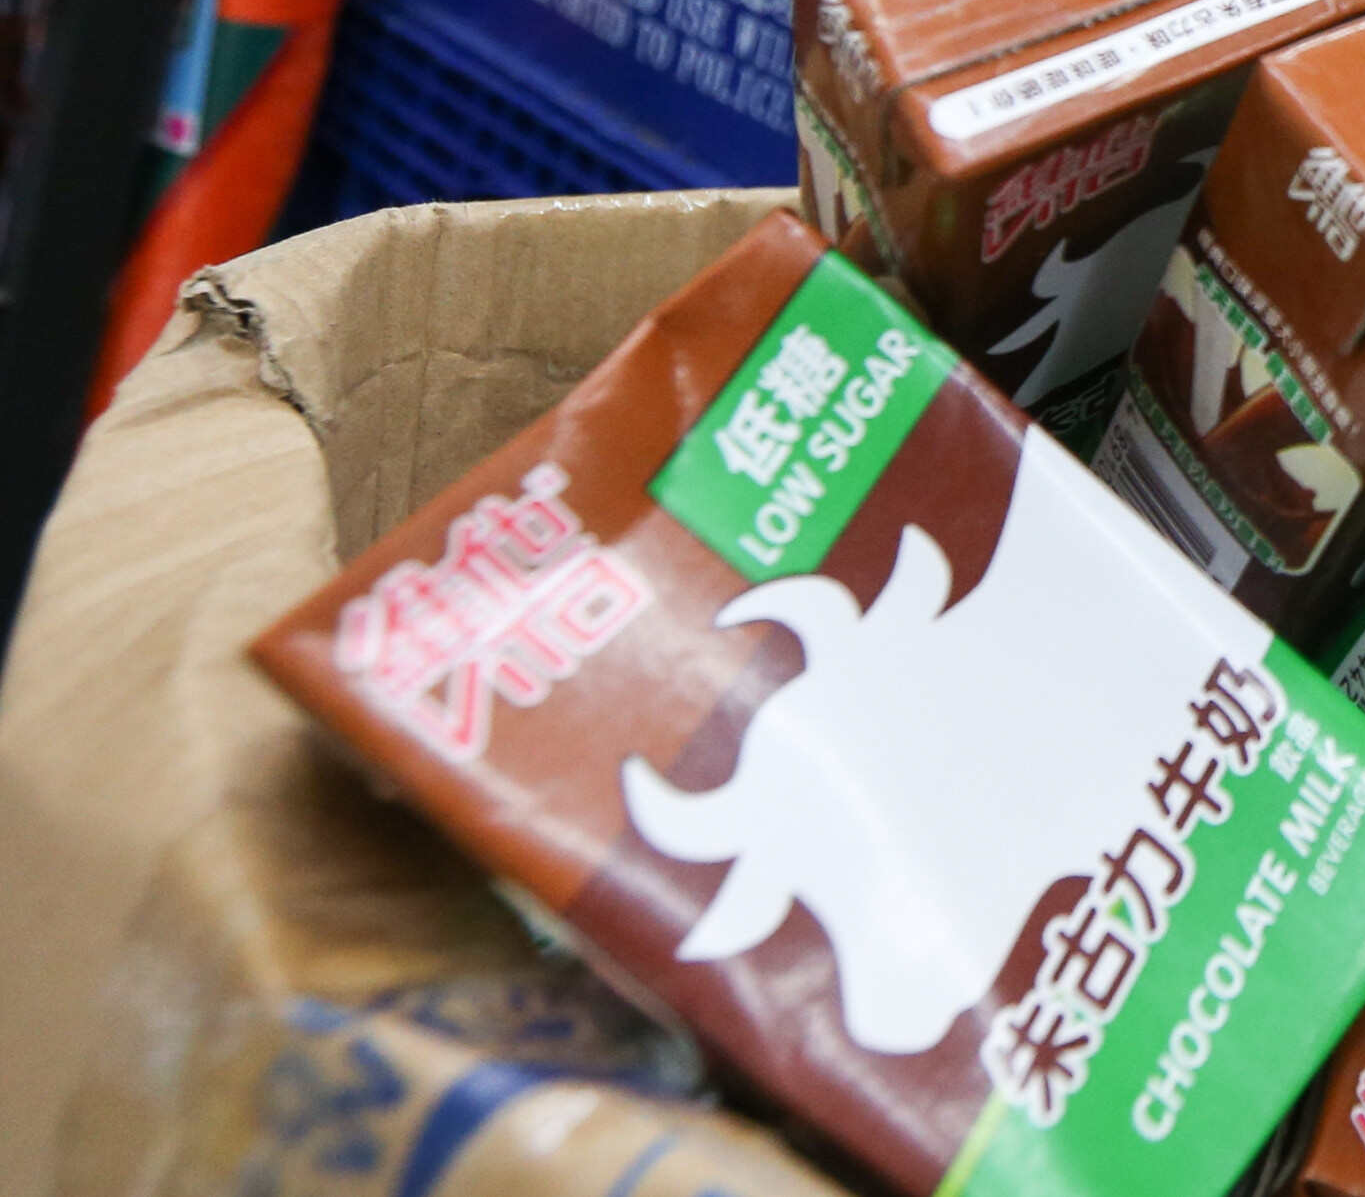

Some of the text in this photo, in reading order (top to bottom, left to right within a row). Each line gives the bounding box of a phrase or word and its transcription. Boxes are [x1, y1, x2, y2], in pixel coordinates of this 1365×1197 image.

[712, 322, 850, 488] 低糖
[738, 326, 922, 567] LOW SUGAR
[1003, 653, 1284, 1121] 朱古力牛奶
[1130, 735, 1361, 1143] CHOCOLATE MILK
